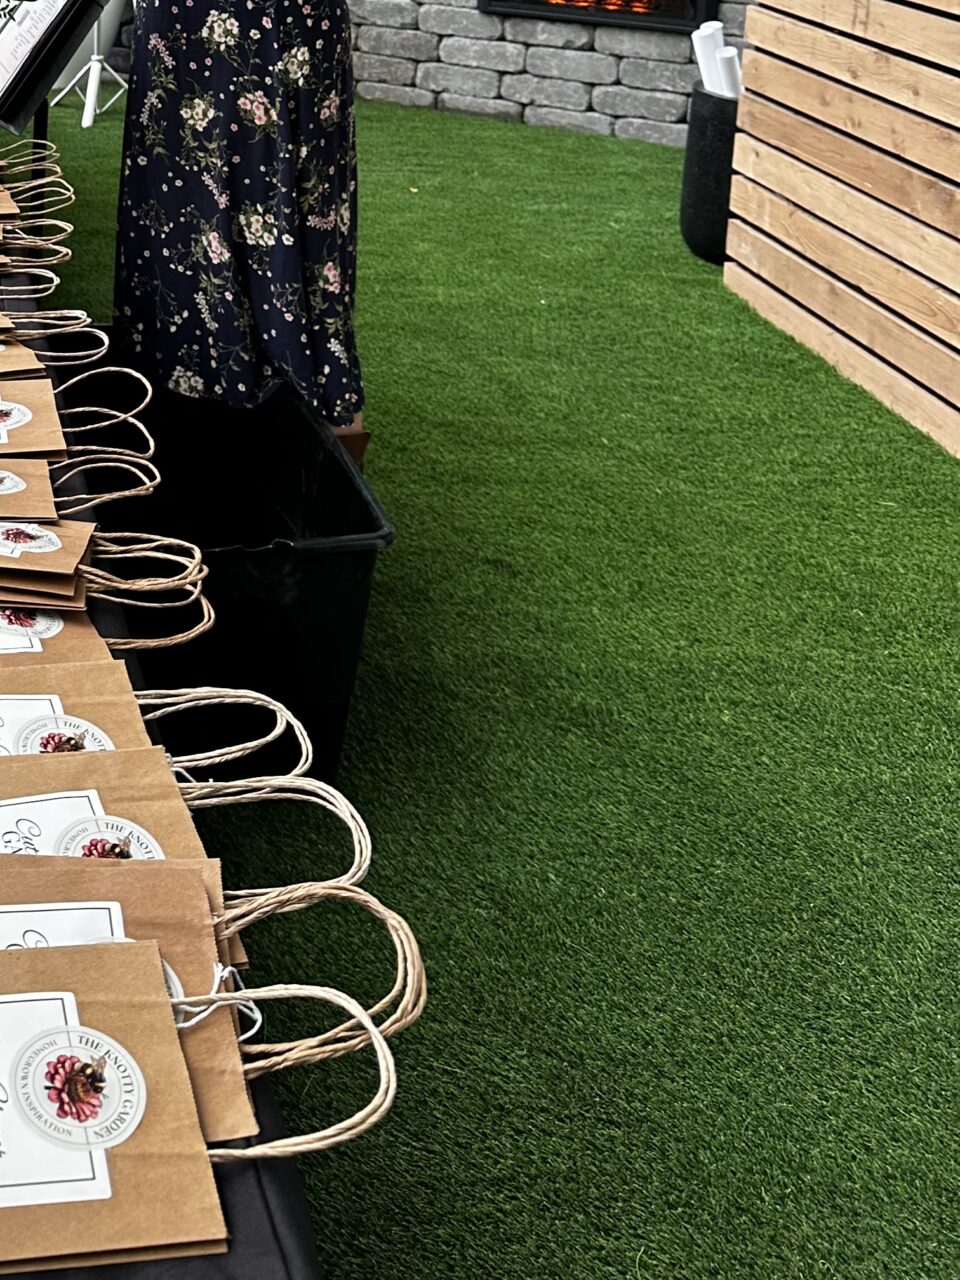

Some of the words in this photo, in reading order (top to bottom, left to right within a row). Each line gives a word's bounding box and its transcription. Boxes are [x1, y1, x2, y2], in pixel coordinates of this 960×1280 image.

[20, 1039, 58, 1091] HOMEGROWN
[77, 1035, 105, 1052] THE
[103, 1049, 135, 1097] KNOTTY
[22, 1091, 72, 1137] INSPIRATION
[94, 1099, 134, 1140] GARDEN
